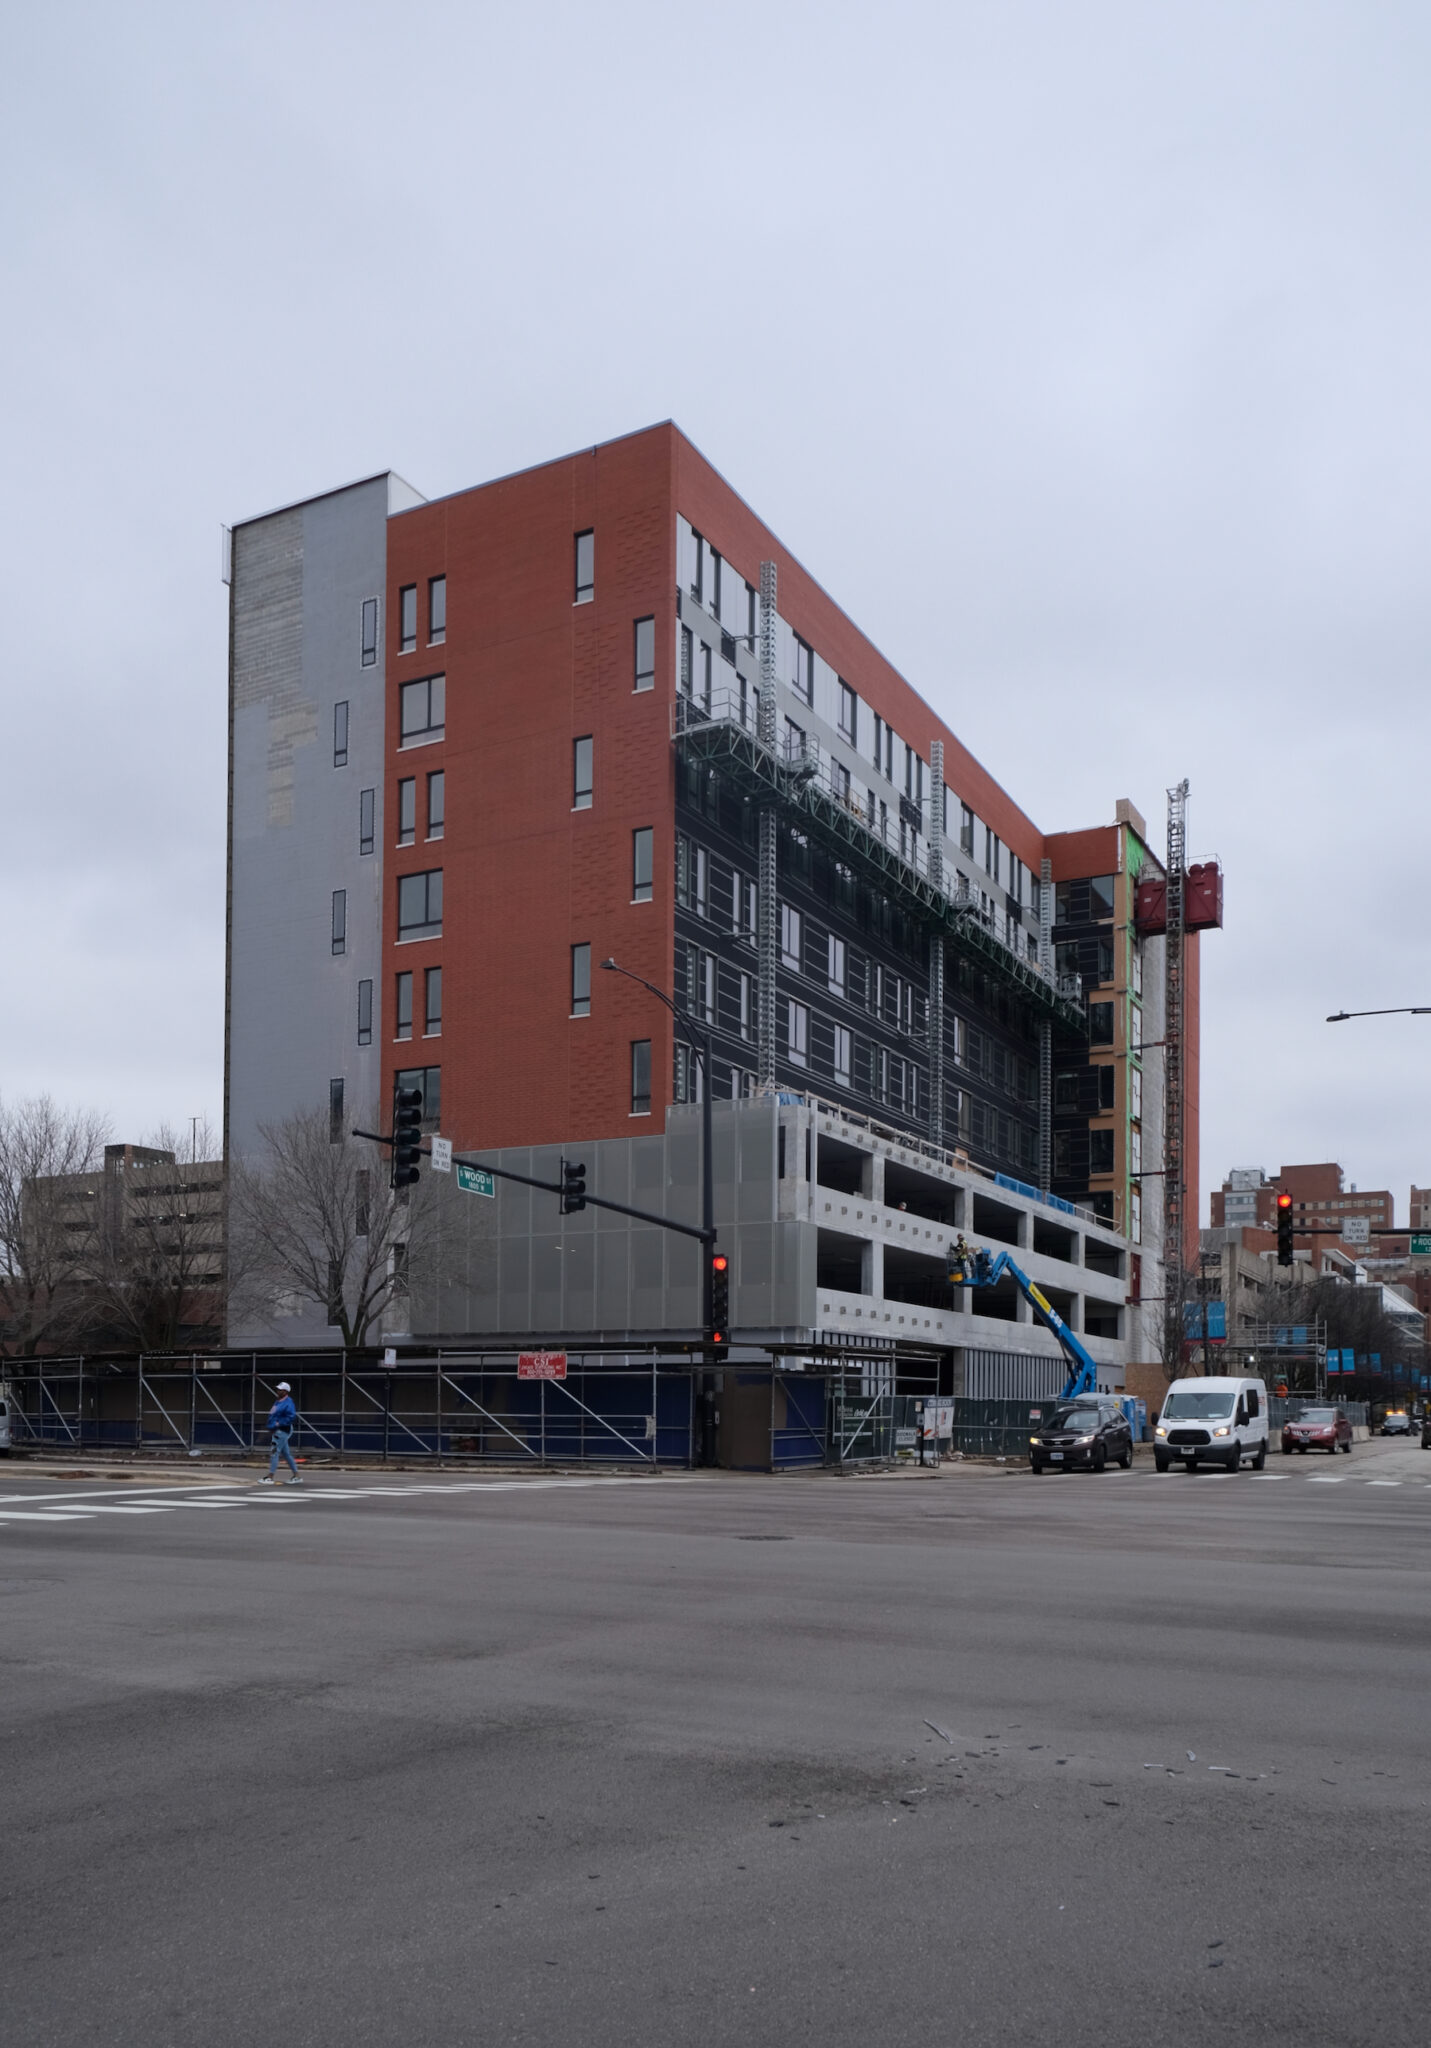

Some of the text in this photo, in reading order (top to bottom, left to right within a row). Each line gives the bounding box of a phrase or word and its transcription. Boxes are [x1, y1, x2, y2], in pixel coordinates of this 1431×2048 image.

[438, 1142, 447, 1150] NO
[436, 1150, 448, 1159] TURN
[441, 1160, 450, 1169] RED
[464, 1170, 485, 1184] WOOD
